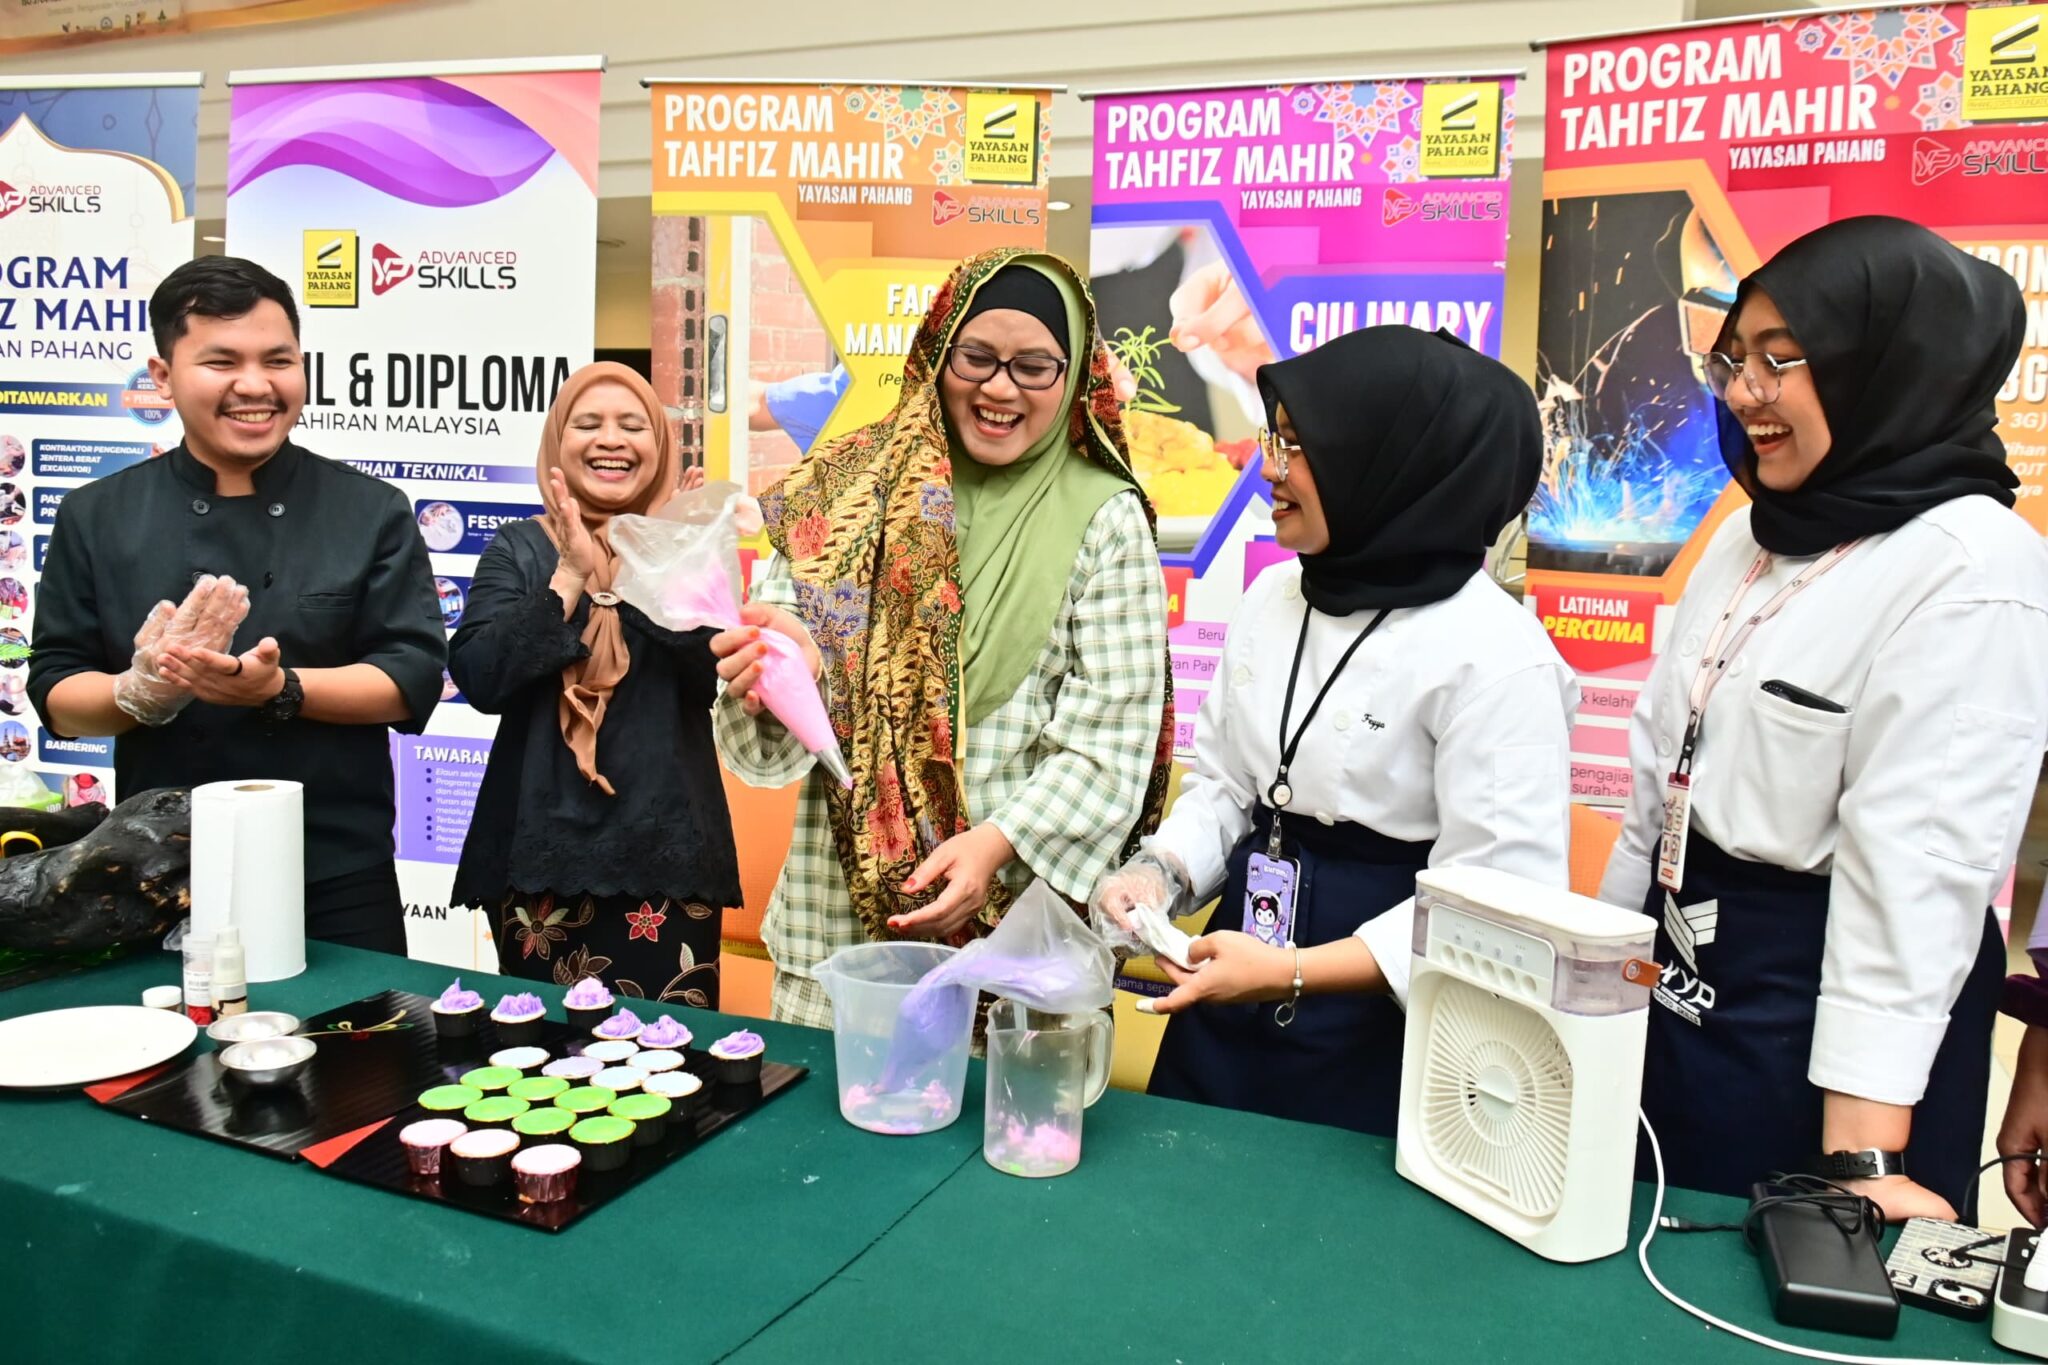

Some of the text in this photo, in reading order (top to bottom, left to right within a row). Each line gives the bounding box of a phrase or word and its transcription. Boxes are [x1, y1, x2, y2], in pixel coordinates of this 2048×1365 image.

[1563, 33, 1782, 98] PROGRAM
[664, 93, 834, 133] PROGRAM
[1107, 98, 1281, 143] PROGRAM
[1560, 84, 1878, 152] TAHFIZ MAHIR
[969, 141, 1029, 152] YAYASAN
[1426, 133, 1491, 145] YAYASAN
[664, 140, 904, 180] TAHFIZ MAHIR
[970, 153, 1027, 164] PAHANG
[1426, 146, 1488, 157] PAHANG
[1729, 138, 1886, 169] YAYASAN PAHANG
[1105, 143, 1355, 190] TAHFIZ MAHIR
[29, 185, 101, 195] ADVANCED
[798, 184, 912, 205] YAYASAN PAHANG
[1241, 187, 1362, 210] YAYASAN PAHANG
[29, 196, 101, 213] SKILLS
[1422, 202, 1501, 220] SKILLS
[968, 207, 1040, 224] SKILLS
[418, 250, 517, 264] ADVANCED
[0, 256, 128, 289] GRAM
[307, 271, 352, 280] YAYASAN
[418, 265, 517, 289] SKILLS
[308, 281, 351, 290] PAHANG
[31, 340, 133, 360] PAHANG
[349, 352, 373, 408] &
[386, 414, 501, 436] MALAYSIA
[39, 444, 144, 455] KONTRAKTOR PENGENDALI
[75, 455, 102, 463] BERAT
[39, 465, 91, 474] (EXCAVATOR)
[401, 463, 488, 481] TEKNIKAL
[1559, 596, 1629, 617] LATIHAN
[1543, 616, 1646, 644] PERCUMA
[45, 739, 108, 754] BARBERING
